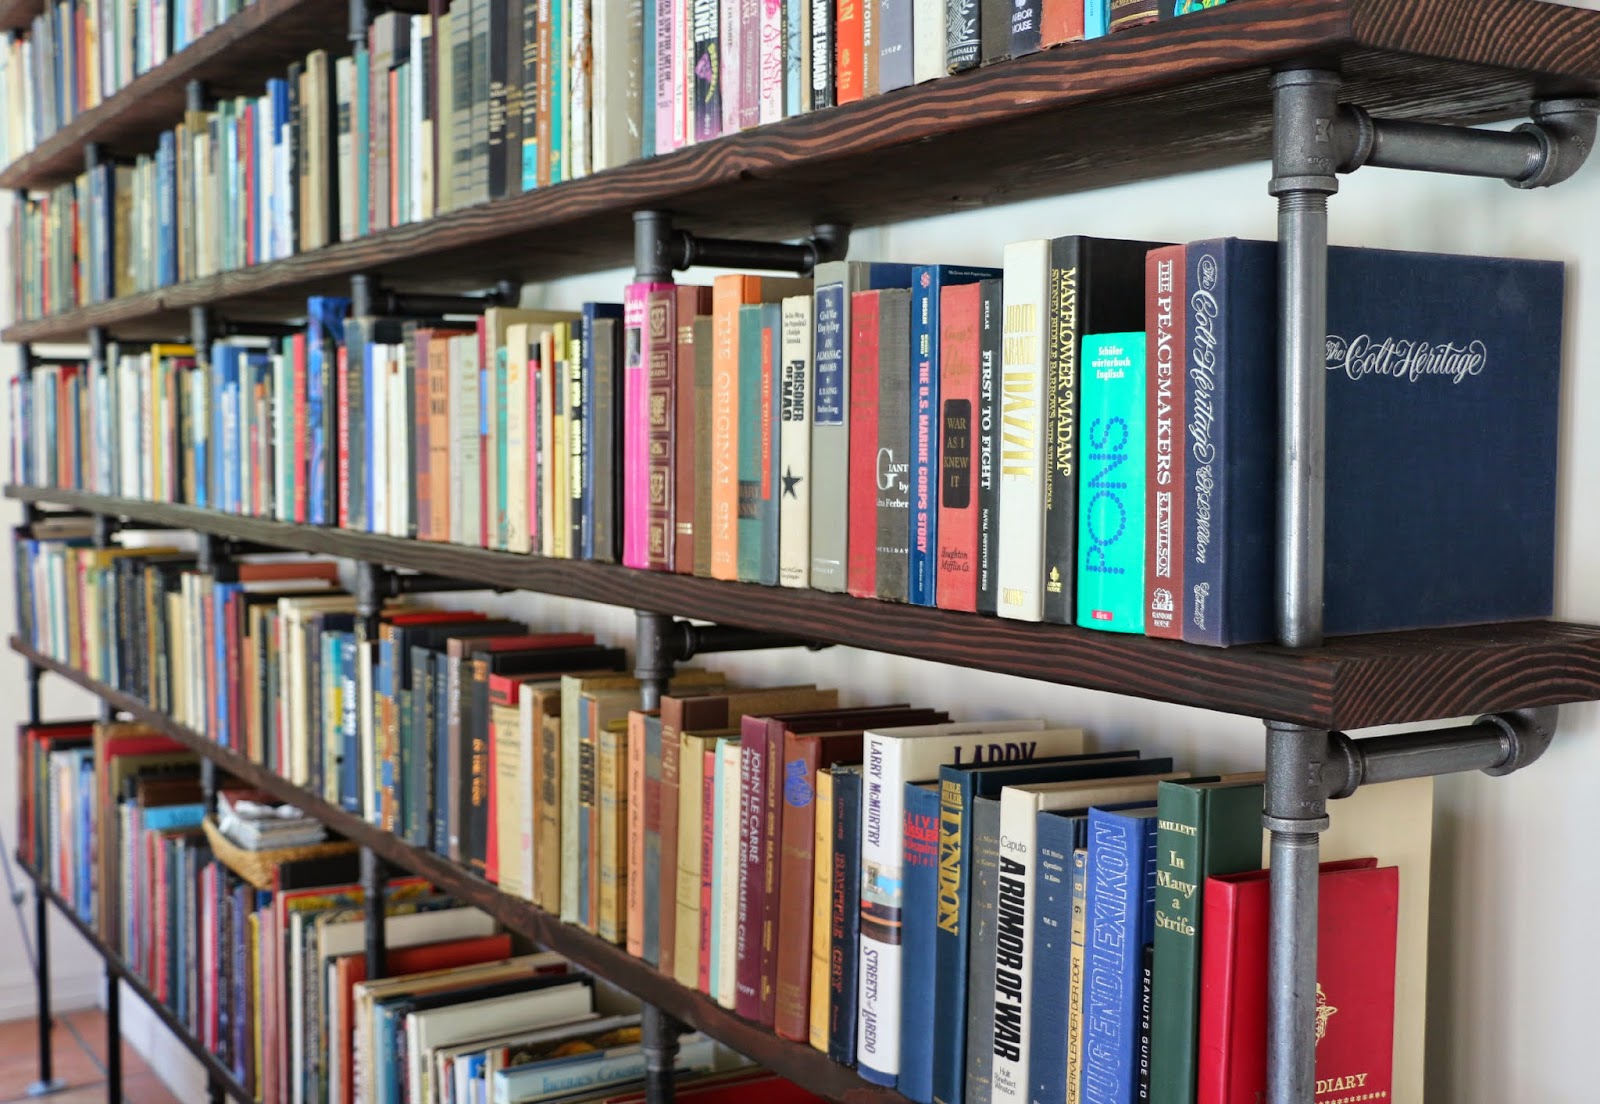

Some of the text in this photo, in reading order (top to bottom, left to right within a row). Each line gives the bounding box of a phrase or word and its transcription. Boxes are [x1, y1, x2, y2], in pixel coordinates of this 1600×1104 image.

[763, 24, 772, 99] OF NEED
[772, 26, 781, 83] A CASE
[813, 0, 826, 90] LMORE LEONARD
[1159, 260, 1173, 293] THE
[719, 312, 731, 359] THE
[1050, 316, 1058, 359] BIDDLE
[1191, 289, 1218, 351] Colt
[817, 349, 841, 360] ALMANAC
[1091, 356, 1131, 367] wörterbuch
[1098, 346, 1123, 356] Schüler
[1345, 334, 1394, 380] Colt
[1392, 339, 1487, 384] Heritage
[785, 366, 793, 378] OF
[791, 360, 805, 421] PRISONER
[1048, 360, 1057, 419] BARROWS
[1056, 267, 1076, 477] MAYFLOWER MADAM
[1096, 369, 1124, 380] Englisch
[1157, 296, 1173, 485] PEACEMAKERS
[782, 380, 793, 421] MAO
[981, 350, 992, 490] FIRST TO FIGHT
[1188, 348, 1216, 464] Heritage
[717, 371, 730, 484] ORIGINAL
[947, 417, 966, 430] WAR
[947, 437, 957, 448] AS
[917, 361, 929, 554] THE U.S. MARINE CORPS STORY
[944, 456, 968, 468] KNEW
[899, 481, 909, 493] by
[950, 476, 960, 487] IT
[1086, 416, 1129, 575] PONS
[717, 502, 729, 541] SIN
[885, 498, 909, 508] Ferber
[1158, 519, 1170, 576] WILSON
[750, 748, 761, 794] JOHN
[869, 739, 883, 779] LARRY
[750, 795, 760, 813] LE
[1000, 836, 1027, 853] Caputo
[1158, 820, 1197, 836] MILLETT
[737, 747, 751, 960] THE LITTLE DRUMMER GIRL
[937, 806, 963, 936] LYNDON
[1168, 850, 1185, 869] In
[1156, 870, 1197, 899] Many
[1171, 898, 1181, 909] a
[832, 852, 846, 993] BATTLE CRY
[1155, 911, 1195, 936] Strife
[993, 855, 1025, 1062] A RUMOR OF WAR
[862, 945, 879, 1055] STREETS LAREDO
[1070, 986, 1079, 1010] DER
[1139, 968, 1150, 1098] PEANUTS GUIDE TO
[1000, 1067, 1010, 1078] Holt
[1315, 1073, 1368, 1094] DIARY
